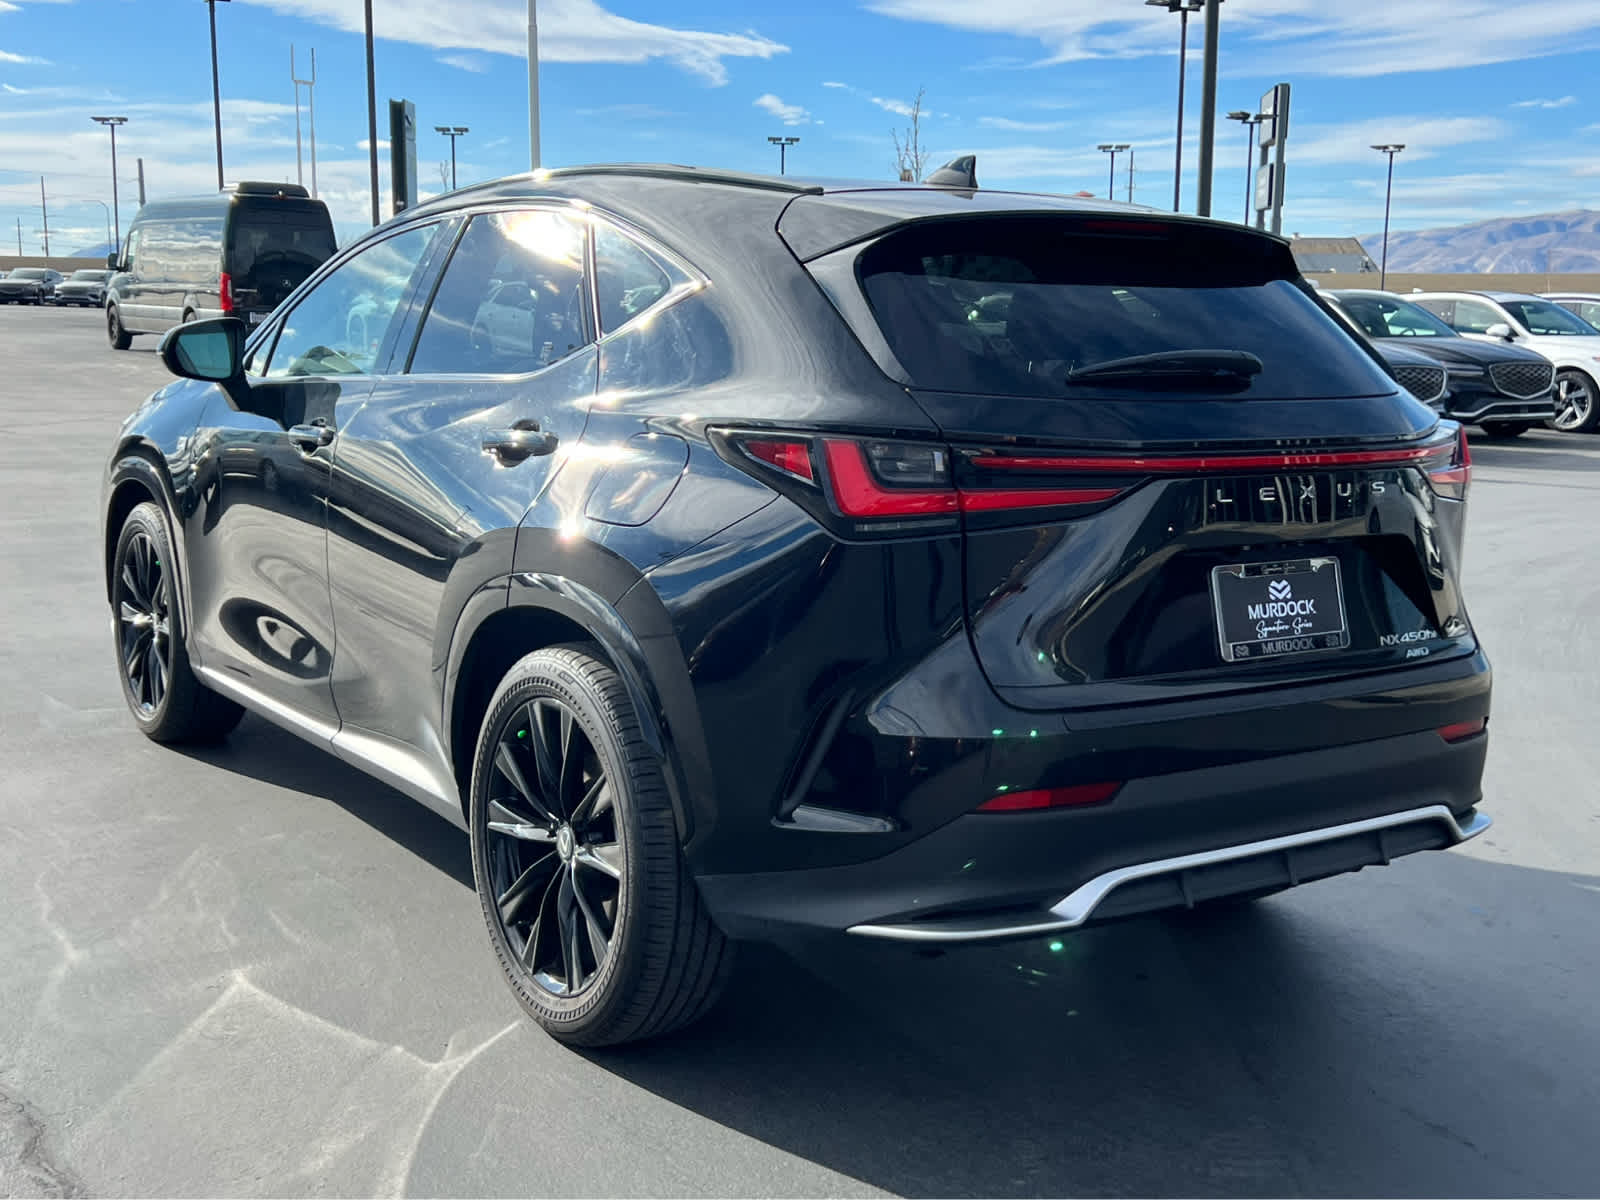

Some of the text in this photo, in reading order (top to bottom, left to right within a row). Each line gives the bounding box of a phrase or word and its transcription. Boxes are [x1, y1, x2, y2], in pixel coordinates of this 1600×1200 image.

[1216, 481, 1385, 503] LEXUS
[1247, 599, 1316, 620] MURDOCK
[1261, 637, 1316, 655] MURDOCK
[1406, 646, 1430, 659] AWD
